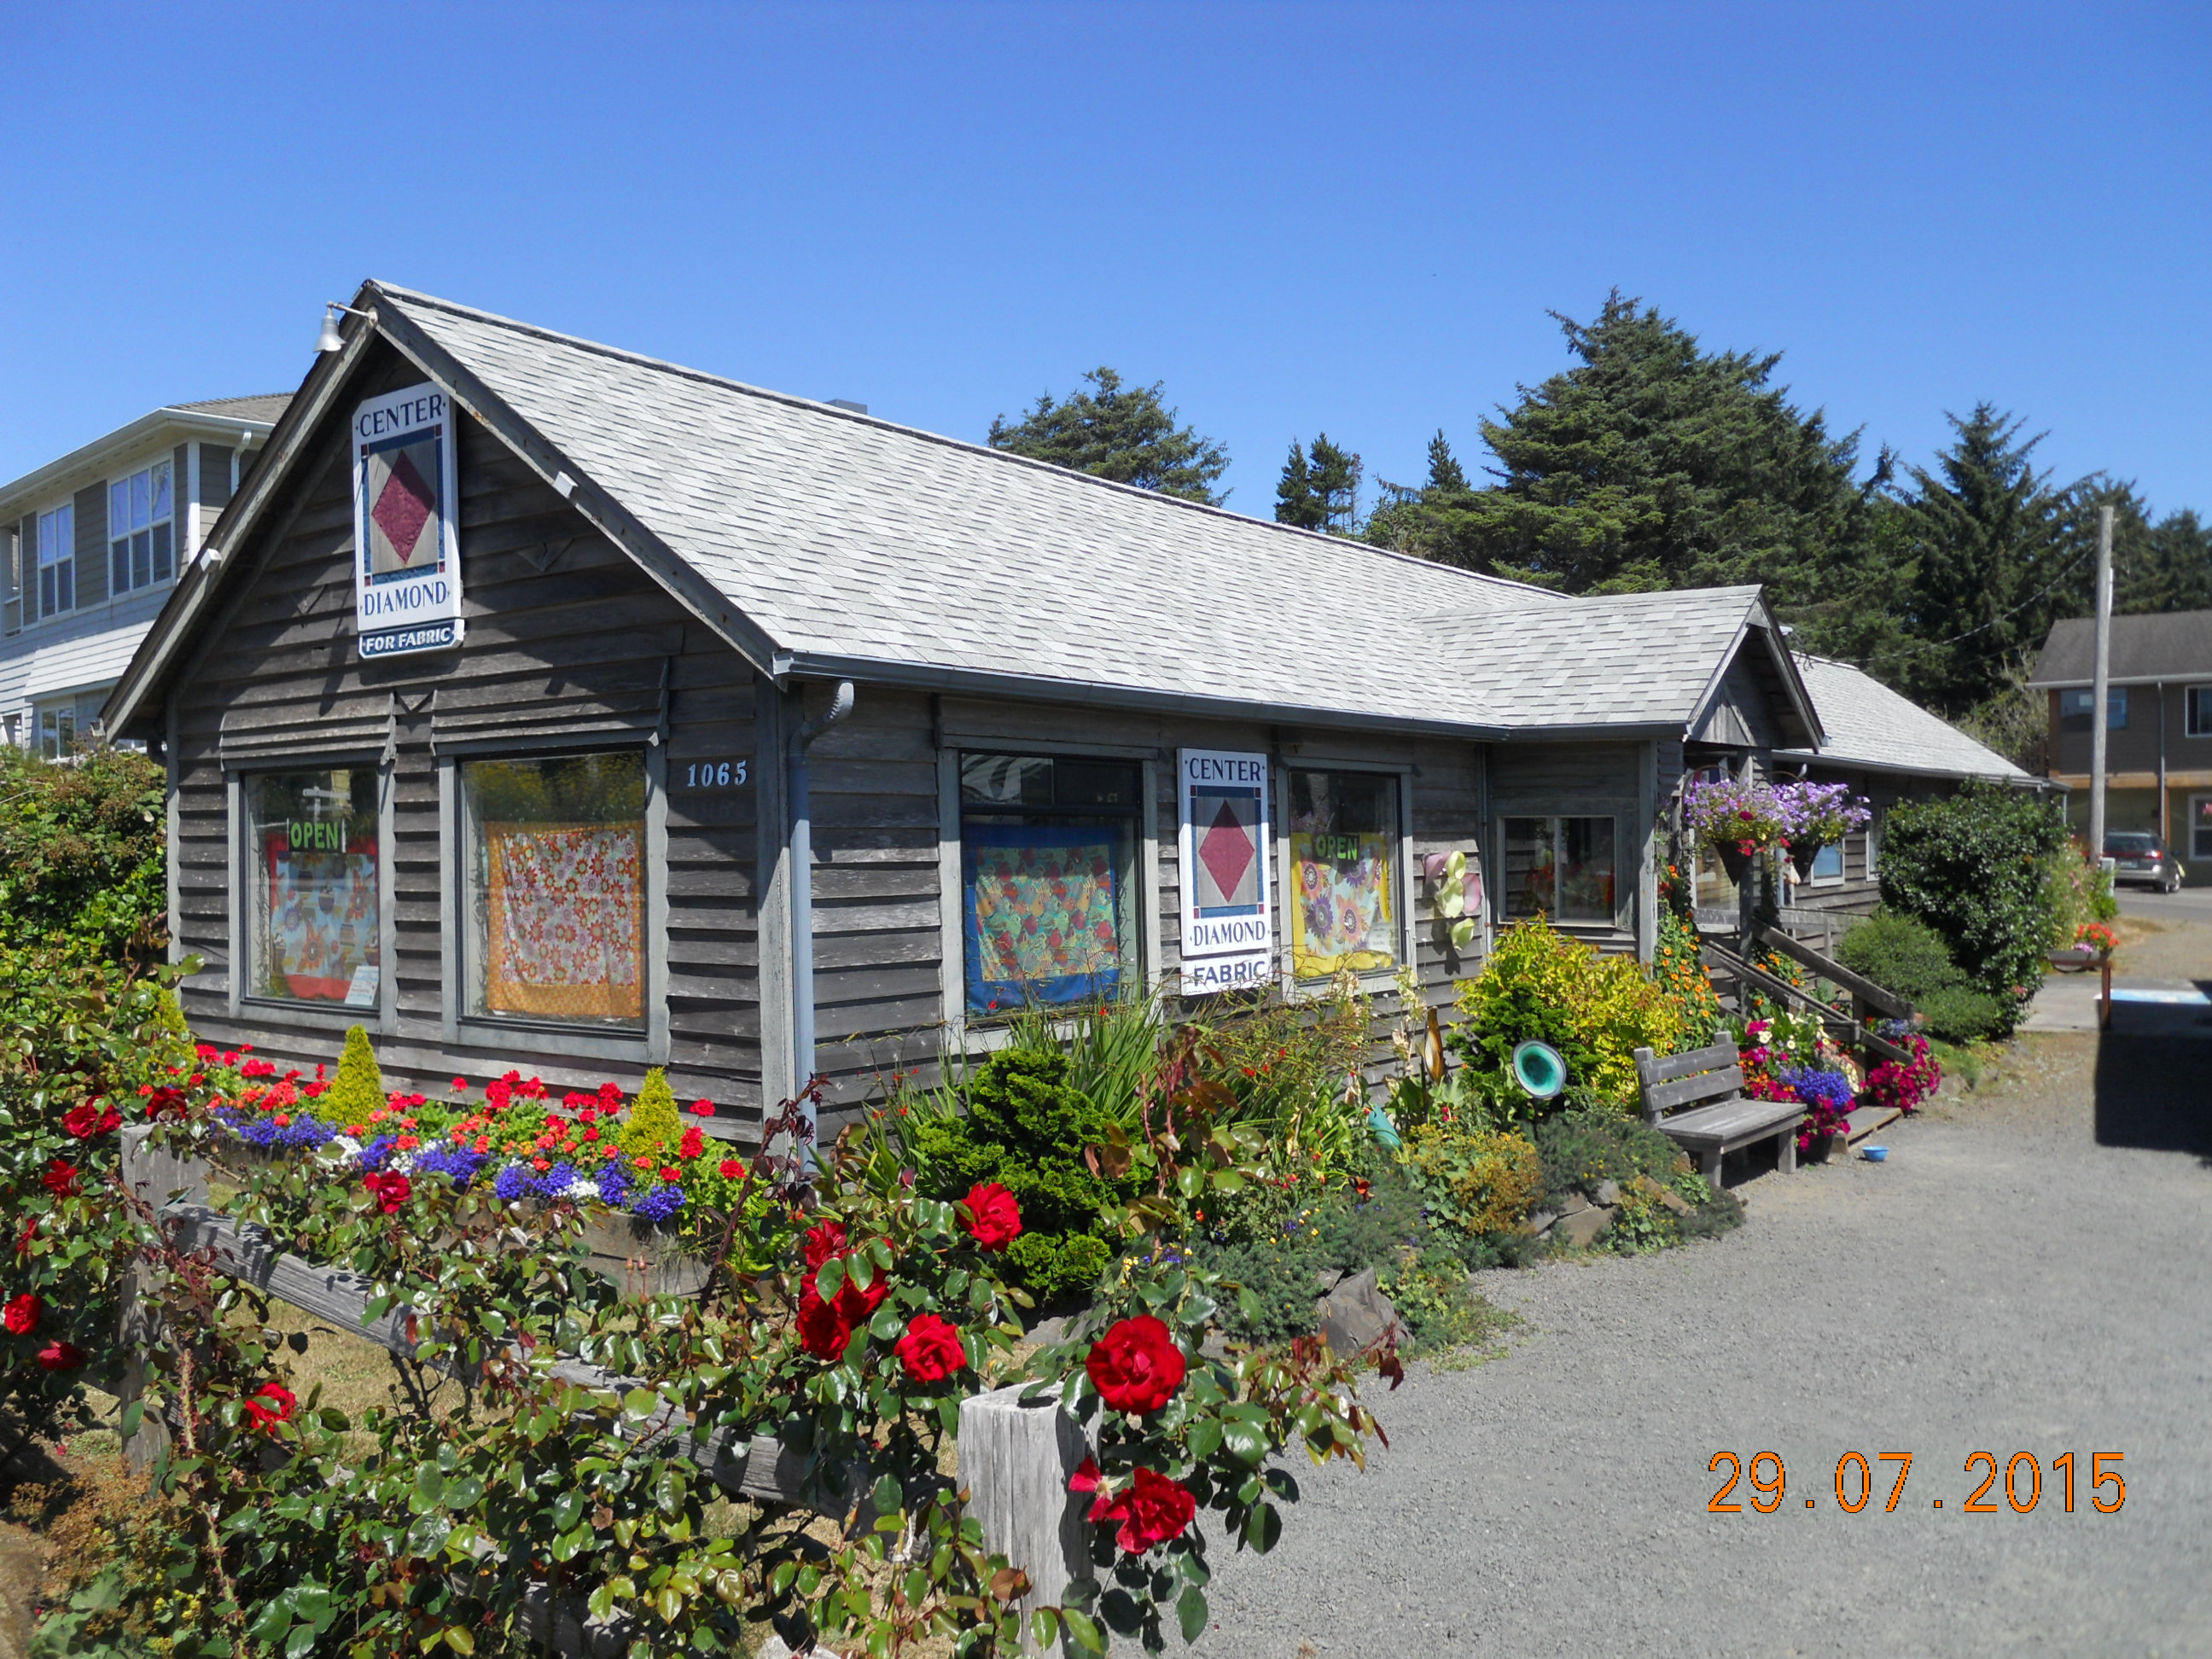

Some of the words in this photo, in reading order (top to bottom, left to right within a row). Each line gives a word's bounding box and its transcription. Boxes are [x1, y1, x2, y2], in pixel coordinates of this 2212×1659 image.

[359, 393, 442, 437] CENTER
[364, 581, 447, 616] DIAMOND
[366, 635, 395, 652] FOR
[399, 627, 451, 648] FABRIC
[687, 760, 748, 787] 1065
[1189, 758, 1261, 782] CENTER
[290, 822, 339, 849] OPEN
[1315, 834, 1358, 861] OPEN
[1194, 921, 1266, 946] DIAMOND
[1194, 961, 1266, 987] FABRIC
